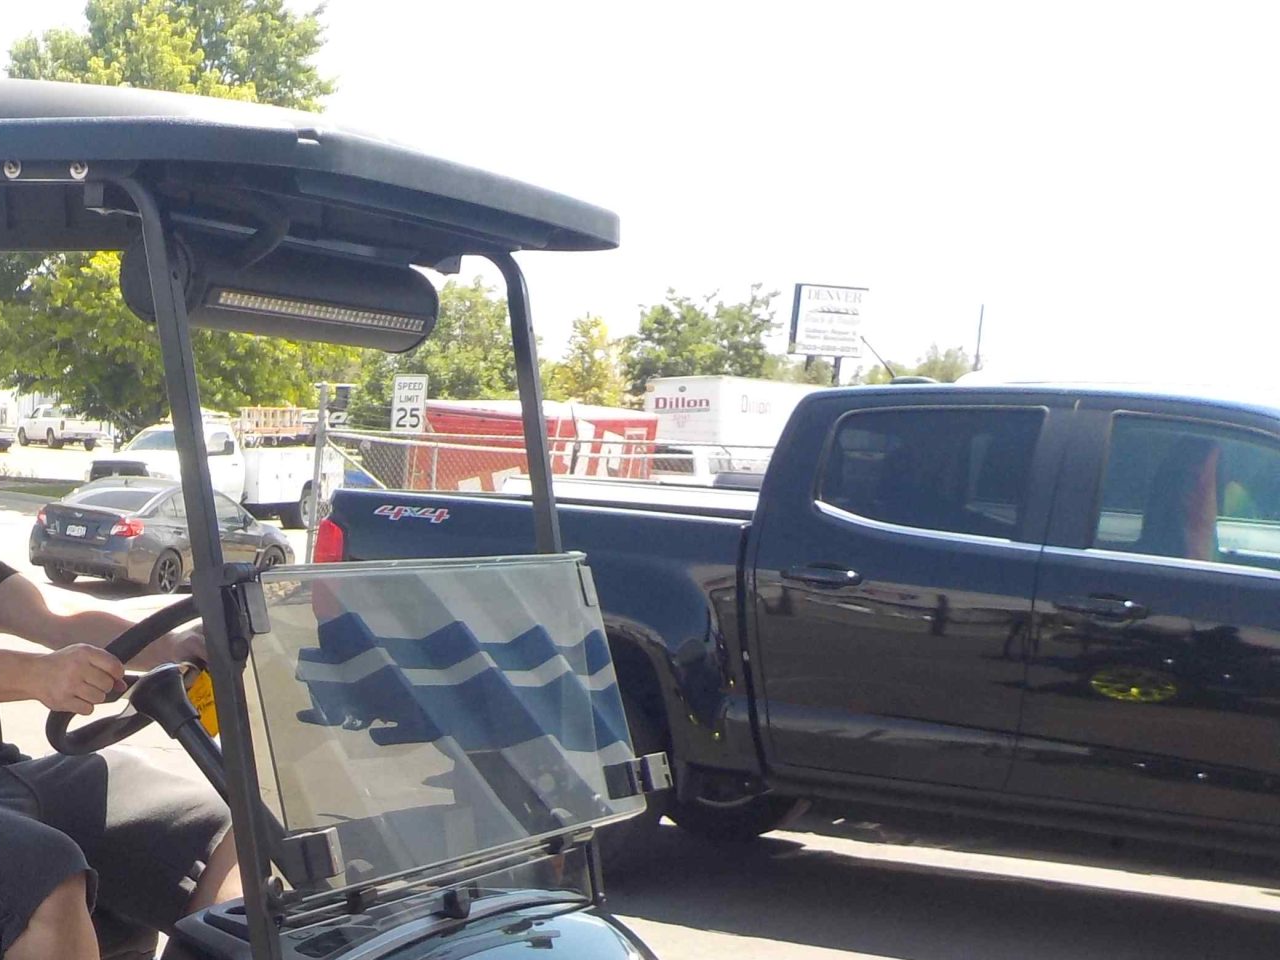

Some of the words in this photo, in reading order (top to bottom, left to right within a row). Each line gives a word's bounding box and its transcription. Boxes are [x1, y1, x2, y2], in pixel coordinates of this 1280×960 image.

[808, 289, 862, 303] DENVER
[397, 382, 424, 391] SPEED
[400, 395, 420, 403] LIMIT
[655, 396, 711, 409] Dillon
[396, 407, 421, 428] 25
